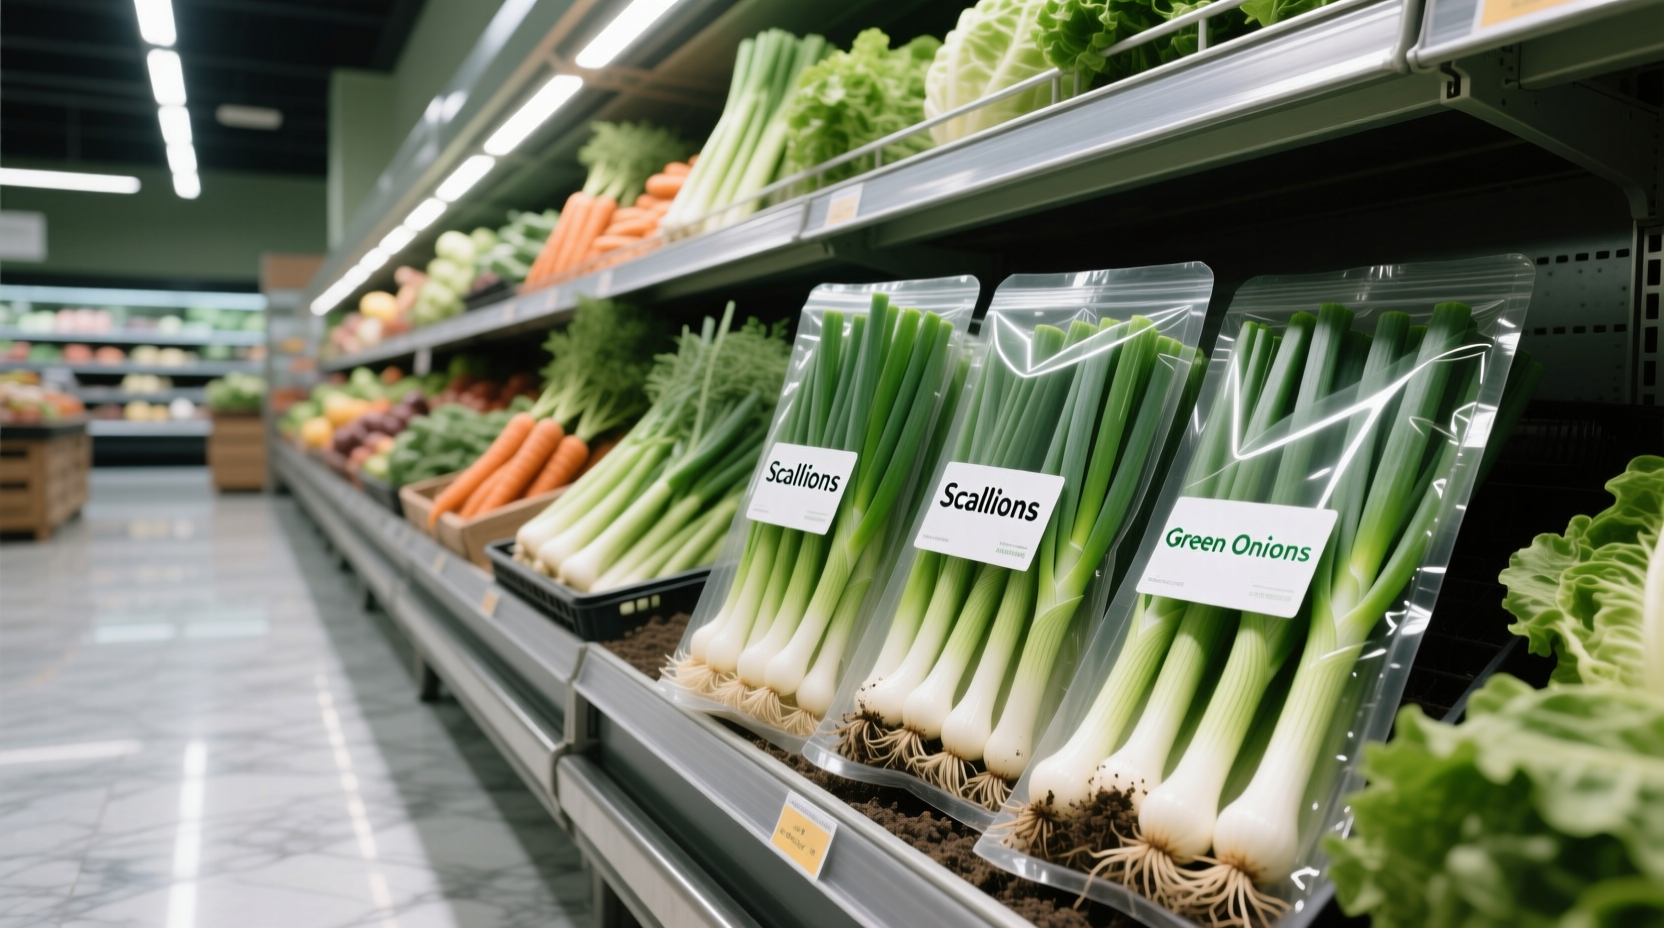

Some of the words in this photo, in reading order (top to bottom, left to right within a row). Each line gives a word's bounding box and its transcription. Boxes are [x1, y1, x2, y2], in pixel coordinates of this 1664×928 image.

[766, 461, 840, 492] Scallions
[940, 482, 1040, 521] Scallions
[1166, 527, 1226, 553] Green
[1232, 534, 1311, 562] Onions
